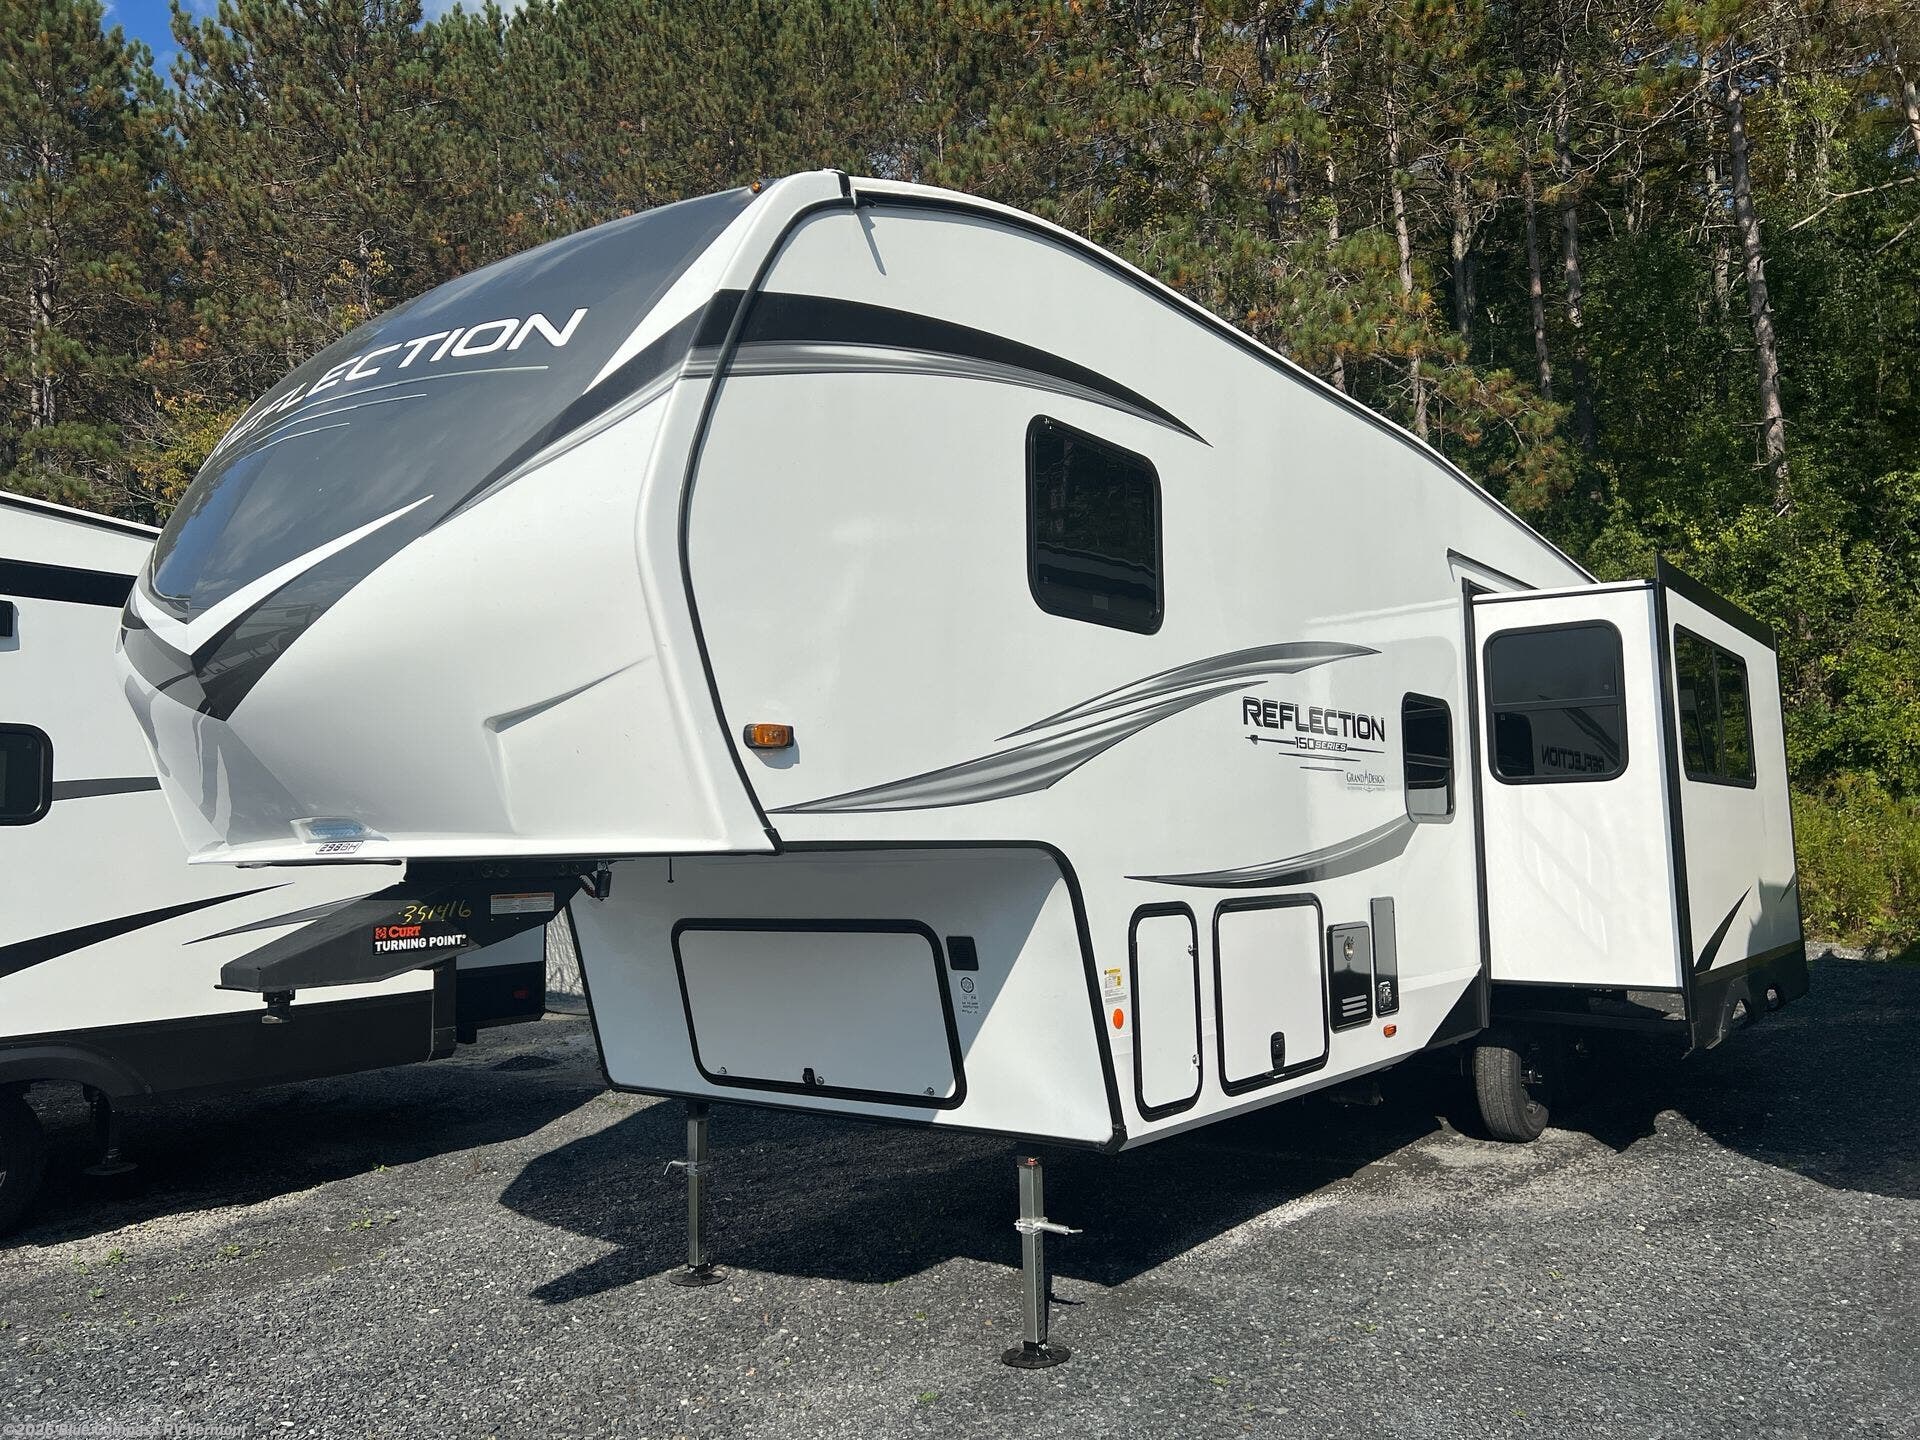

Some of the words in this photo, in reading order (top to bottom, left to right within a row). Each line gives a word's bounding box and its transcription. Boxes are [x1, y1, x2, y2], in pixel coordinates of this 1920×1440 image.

[1242, 696, 1385, 742] REFLECTION
[1315, 740, 1347, 752] SERIES
[388, 926, 421, 938] CURT
[375, 938, 426, 952] TURNING
